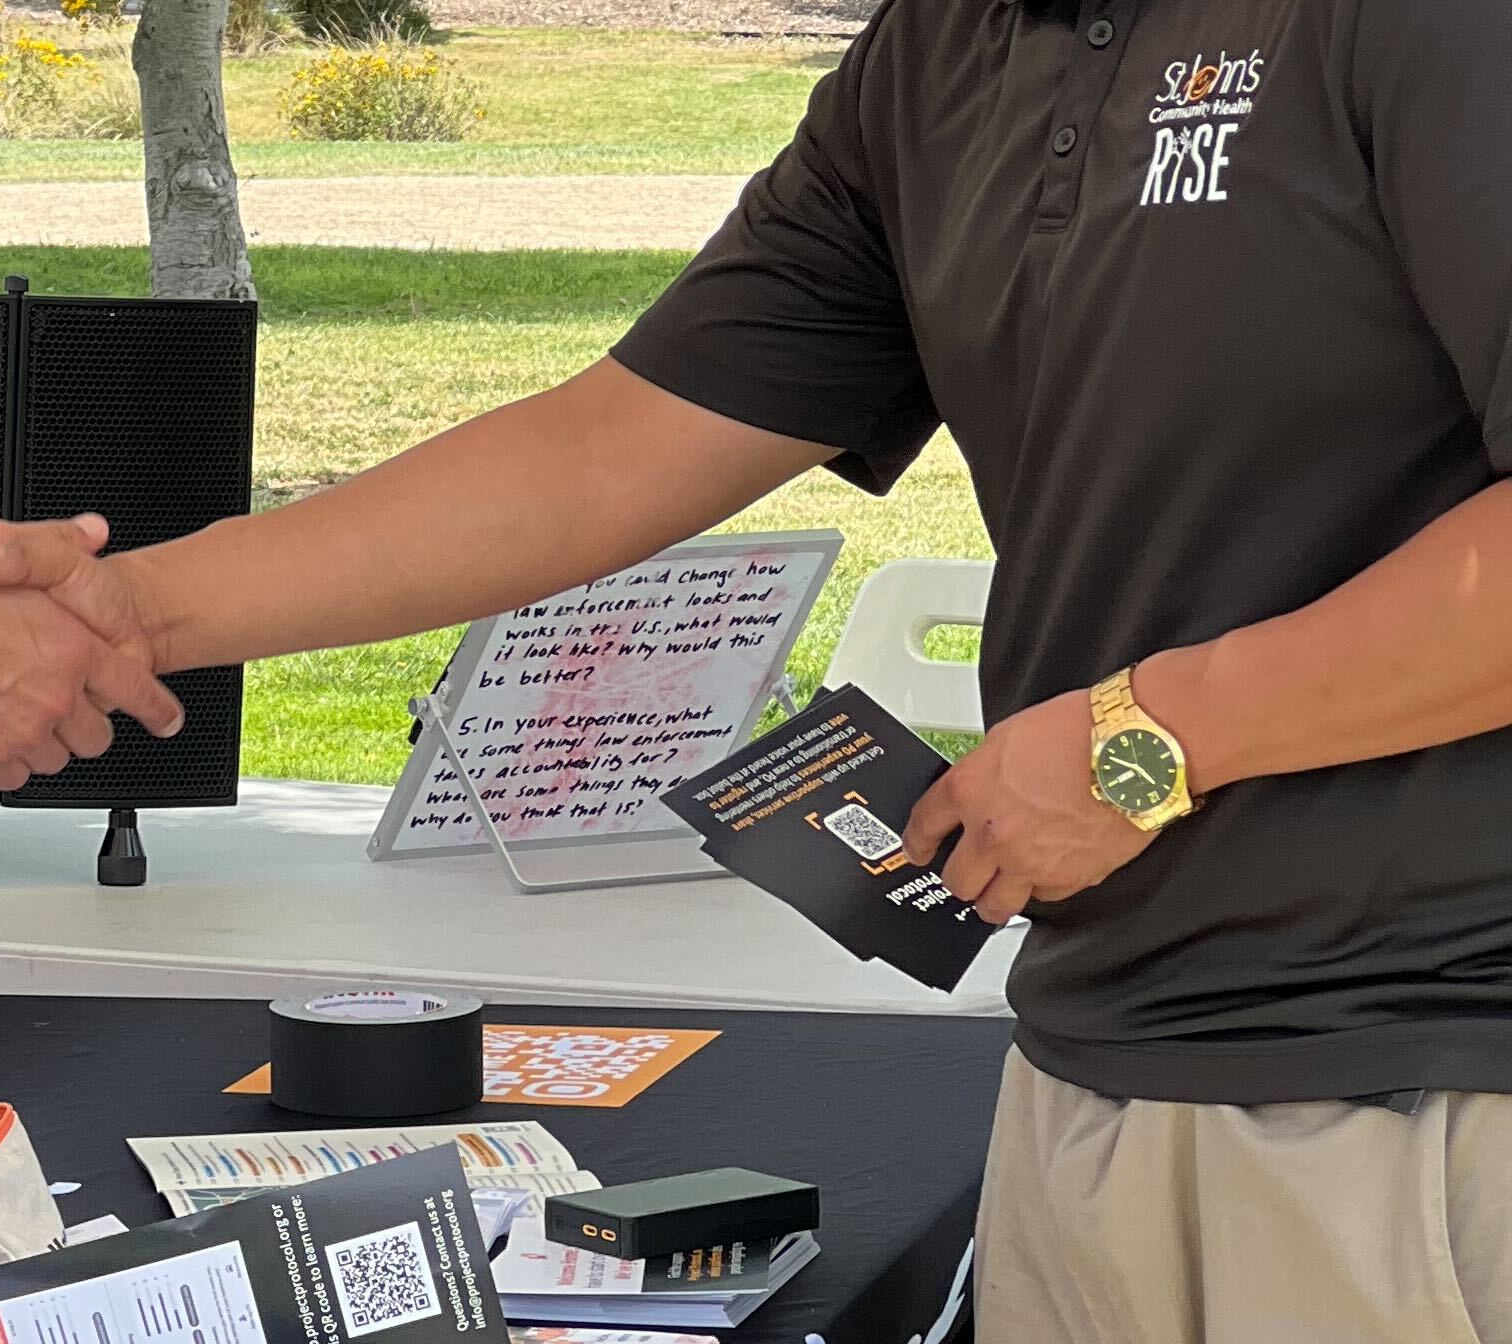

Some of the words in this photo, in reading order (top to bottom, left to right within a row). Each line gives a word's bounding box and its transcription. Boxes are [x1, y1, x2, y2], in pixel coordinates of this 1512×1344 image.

[746, 561, 786, 576] how
[686, 592, 732, 607] looks
[737, 588, 773, 602] and
[506, 626, 556, 640] works
[565, 624, 582, 636] in
[729, 612, 782, 628] would
[494, 644, 514, 661] it
[523, 643, 562, 658] look
[666, 637, 722, 654] would
[729, 632, 765, 648] this
[478, 671, 505, 689] be
[520, 666, 595, 685] better?
[458, 716, 478, 736] 5.
[484, 717, 504, 734] In
[514, 716, 558, 735] your
[666, 705, 713, 724] what
[479, 743, 524, 757] some
[534, 736, 586, 754] things
[594, 732, 629, 748] law
[569, 779, 623, 794] things
[631, 775, 663, 794] they
[453, 813, 472, 824] do
[570, 801, 607, 817] that
[885, 871, 942, 906] Protocol
[912, 887, 952, 912] roject
[270, 1202, 284, 1218] or
[288, 1193, 309, 1232] more:
[423, 1196, 436, 1210] at
[427, 1209, 439, 1225] us
[297, 1232, 318, 1266] learn
[430, 1225, 451, 1270] Contact
[439, 1187, 487, 1330] info@projectprotocol.org
[309, 1266, 322, 1281] to
[311, 1281, 331, 1313] code
[442, 1269, 470, 1332] Questions?
[320, 1313, 337, 1334] QR
